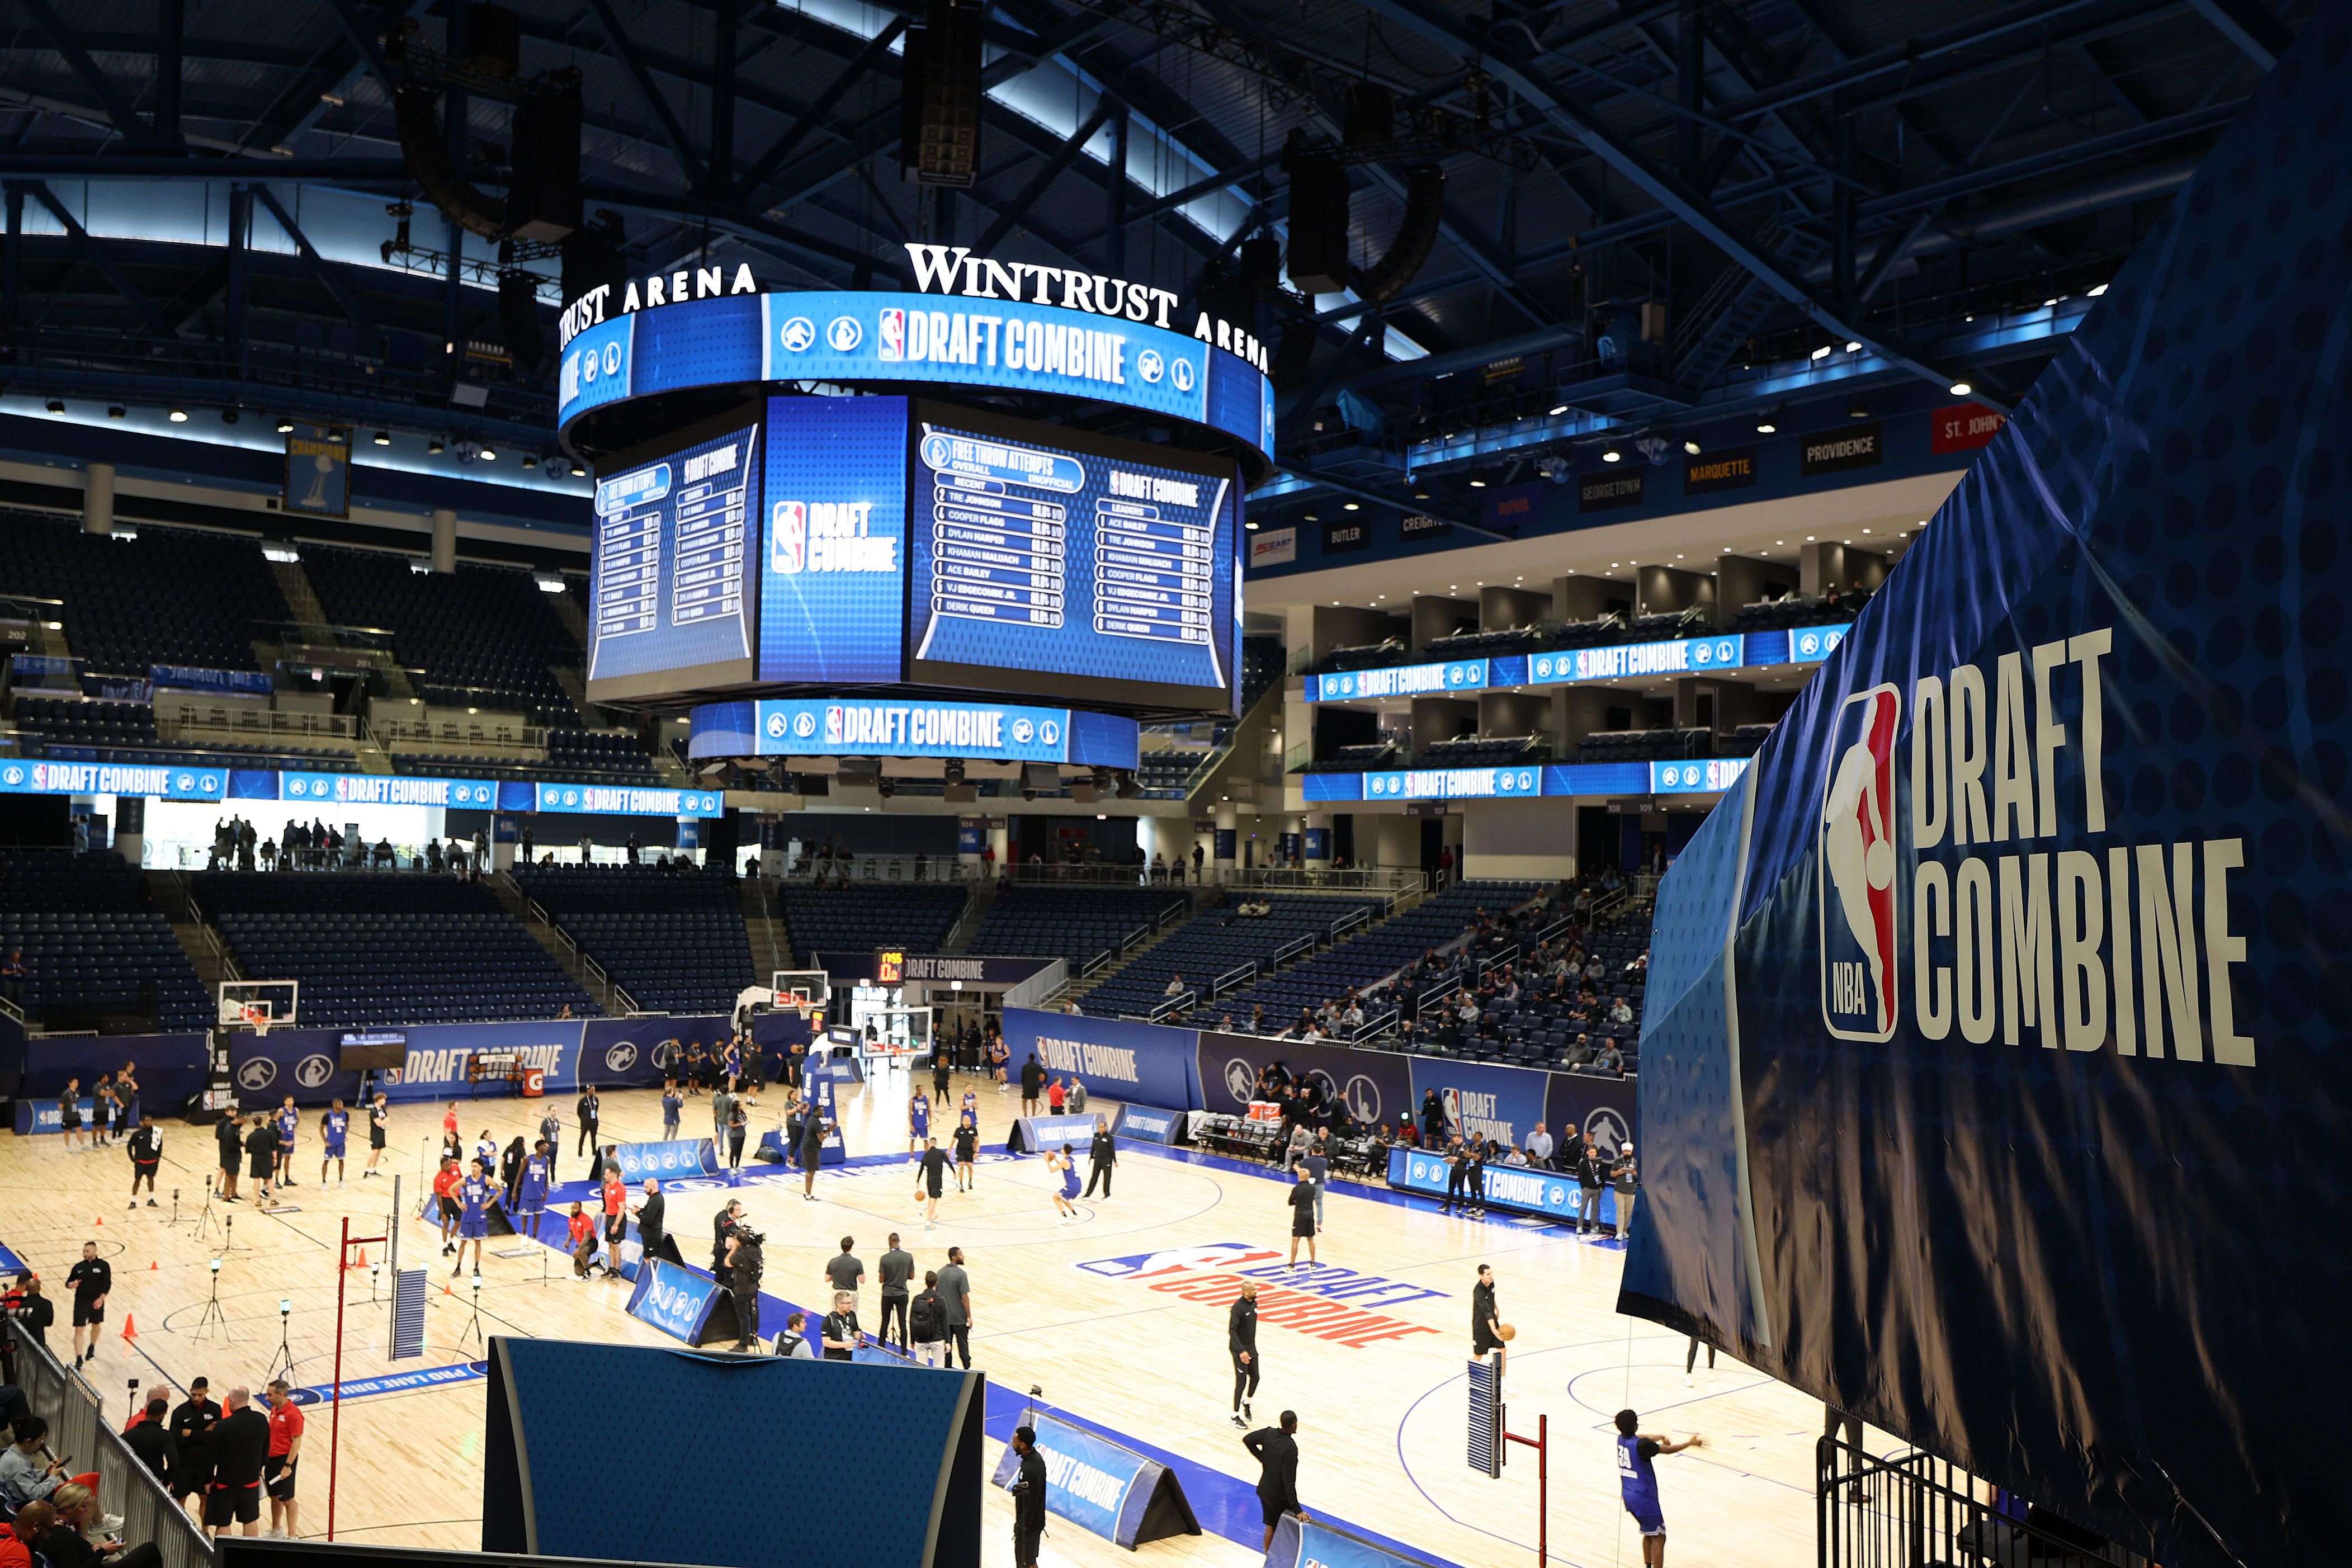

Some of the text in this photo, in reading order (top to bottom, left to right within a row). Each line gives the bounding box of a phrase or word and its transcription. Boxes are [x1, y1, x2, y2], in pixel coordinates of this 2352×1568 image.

[624, 263, 757, 314] ARENA
[904, 243, 1268, 374] WINTRUST ARENA
[908, 310, 1125, 385] DRAFT COMBINE
[952, 440, 1054, 476] FREE THROW ATTEMPTS
[1807, 436, 1874, 462] PROVIDENCE
[952, 460, 991, 475] OVERALL
[1690, 459, 1750, 483] MARQUETTE
[955, 476, 986, 490] RECENT
[1028, 474, 1074, 489] UNOFFICIAL
[1119, 471, 1198, 508] DRAFT COMBINE
[1582, 478, 1641, 502] GEORGETOWN
[939, 488, 945, 502] 2
[949, 492, 964, 503] TRE
[965, 494, 1002, 508] JOHNSON
[810, 503, 871, 537] DRAFT
[948, 510, 979, 523] COOPER
[980, 514, 1005, 527] FLAGG
[1112, 504, 1144, 516] LEADERS
[1108, 518, 1122, 528] ACE
[1123, 521, 1147, 532] BAILEY
[1403, 516, 1445, 532] CREIGH
[948, 528, 974, 540] DYLAN
[974, 531, 1005, 545] HARPER
[1108, 535, 1121, 545] TRE
[1122, 538, 1156, 550] JOHNSON
[1331, 527, 1361, 544] BUTLER
[808, 537, 897, 573] COMBINE
[947, 547, 981, 559] KHAMAN
[982, 551, 1019, 565] MALUACH
[1107, 552, 1137, 564] KHAMAN
[1138, 556, 1172, 569] MALUACH
[947, 565, 962, 575] ACE
[963, 567, 991, 579] BAILEY
[1107, 569, 1135, 581] COOPER
[1136, 573, 1158, 584] FLAGG
[947, 583, 957, 593] VJ
[958, 584, 1003, 599] EDGECOMBE
[1004, 591, 1017, 600] JR.
[1107, 586, 1116, 596] VJ
[1117, 588, 1158, 601] EDGECOMBE
[946, 601, 969, 612] DERIK
[970, 604, 995, 616] QUEEN
[1107, 603, 1130, 615] DYLAN
[1130, 606, 1158, 617] HARPER
[1107, 621, 1126, 631] DERIK
[1127, 622, 1150, 634] QUEEN
[1588, 642, 1688, 678] DRAFT COMBINE
[1366, 664, 1446, 695] DRAFT COMBINE
[844, 707, 1003, 748] DRAFT COMBINE
[1912, 627, 2112, 849] DRAFT
[47, 766, 169, 794] DRAFT COMBINE
[1414, 769, 1496, 797] DRAFT COMBINE
[347, 778, 449, 805] DRAFT COMBINE
[594, 792, 681, 814] DRAFT COMBINE
[1639, 804, 1652, 813] 109
[1915, 838, 2256, 1067] COMBINE
[906, 959, 984, 979] DRAFT COMBINE
[1833, 962, 1866, 1015] NBA
[404, 1049, 472, 1084] DRAFT
[1047, 1038, 1139, 1083] DRAFT COMBINE
[1462, 1091, 1496, 1120] DRAFT
[1043, 1125, 1094, 1142] DRAFT COMBINE
[1128, 1114, 1169, 1134] DRAFT COMBINE
[1491, 1171, 1545, 1206] COMBINE
[1236, 1260, 1453, 1308] DRAFT
[1148, 1274, 1442, 1349] COMBINE
[380, 1373, 429, 1388] LANE
[427, 1368, 469, 1381] PRO
[1067, 1461, 1126, 1512] COMBINE
